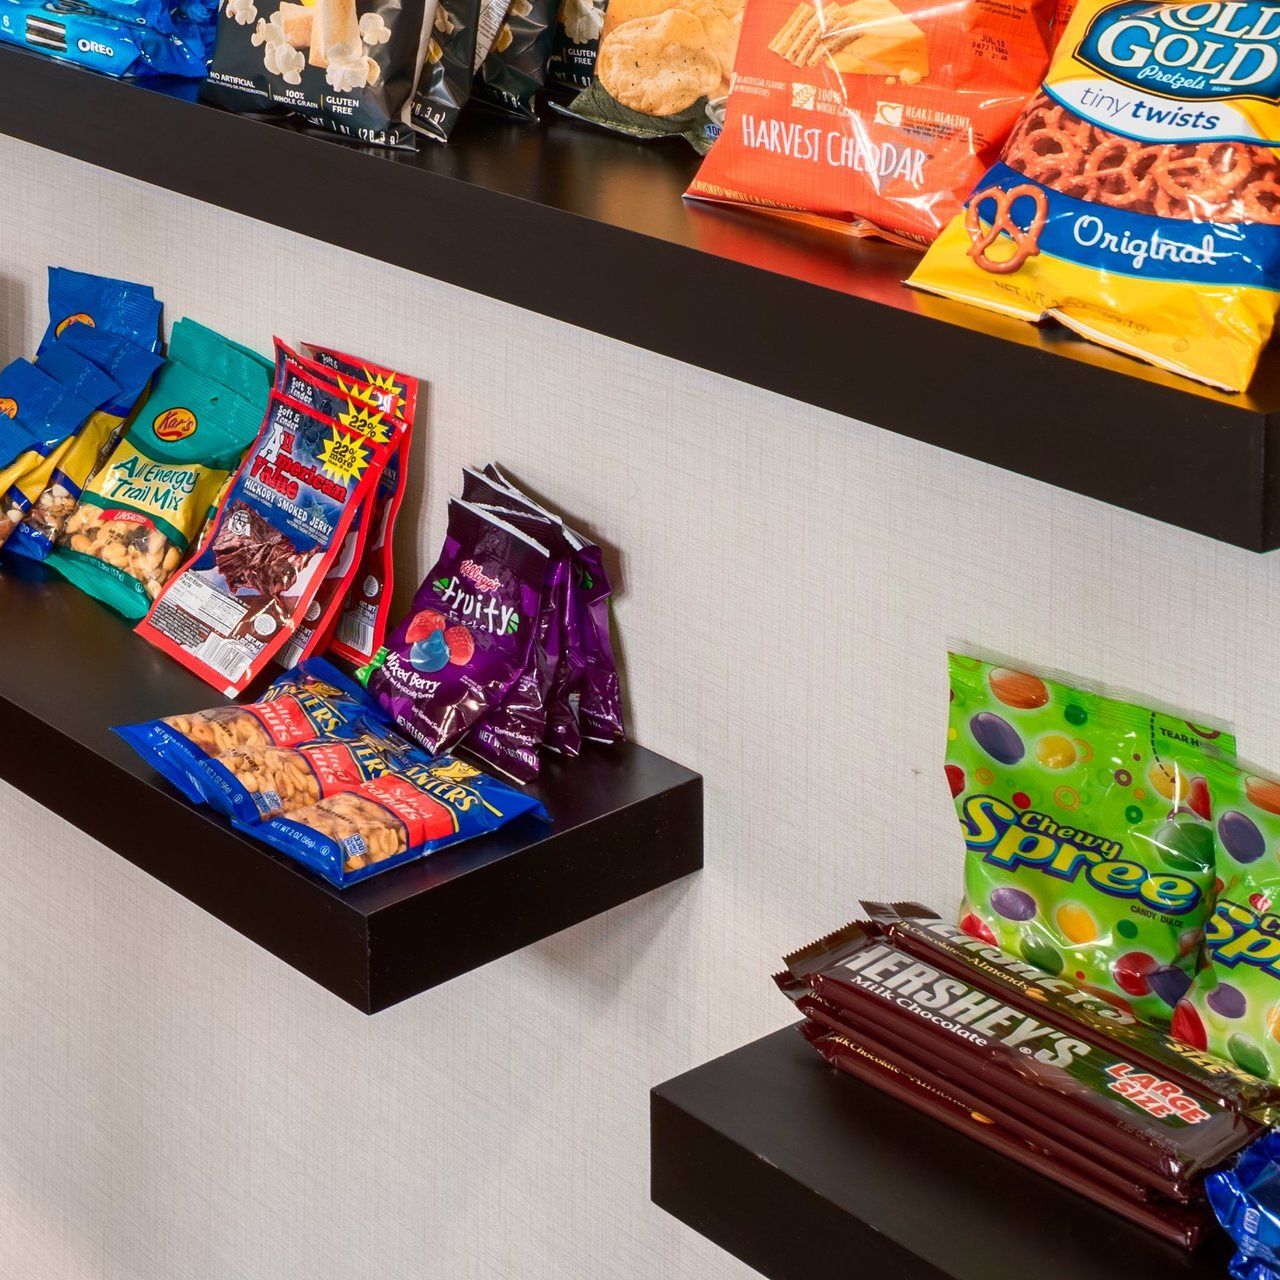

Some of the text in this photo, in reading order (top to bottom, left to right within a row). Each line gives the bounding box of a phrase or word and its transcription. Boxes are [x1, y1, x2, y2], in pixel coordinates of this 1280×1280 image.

[77, 38, 114, 57] OREO
[567, 48, 597, 59] GLUTEN
[574, 55, 593, 66] FREE
[1096, 19, 1278, 86] GOLD
[220, 72, 256, 89] ARTIFICIAL
[1137, 64, 1207, 90] Pretzels
[326, 95, 360, 108] GLUTEN
[331, 104, 354, 116] FREE
[1080, 85, 1221, 132] tiny twists
[742, 113, 823, 162] HARVEST
[1073, 215, 1218, 270] Original
[276, 411, 299, 431] Tender
[277, 404, 294, 418] Soft
[348, 414, 377, 439] 22%
[329, 451, 354, 470] more
[331, 440, 357, 463] 22%
[144, 465, 200, 492] Energy
[115, 477, 184, 512] Trail Mix
[244, 477, 277, 503] HICKORY
[277, 493, 308, 522] SMOKED
[308, 515, 334, 536] JERKY
[459, 558, 501, 592] Kellogg's
[441, 575, 515, 636] fruity
[408, 673, 442, 693] Berry
[1159, 725, 1189, 744] TEAR
[1017, 810, 1124, 859] Chewy
[963, 793, 1203, 916] Spree
[1130, 904, 1159, 921] CANDY
[969, 956, 1030, 992] Almonds
[837, 943, 1093, 1070] HERSHEY'S
[850, 974, 989, 1049] Milk Chocolate
[1105, 1060, 1212, 1125] LARGE
[1107, 1077, 1173, 1120] SIZE
